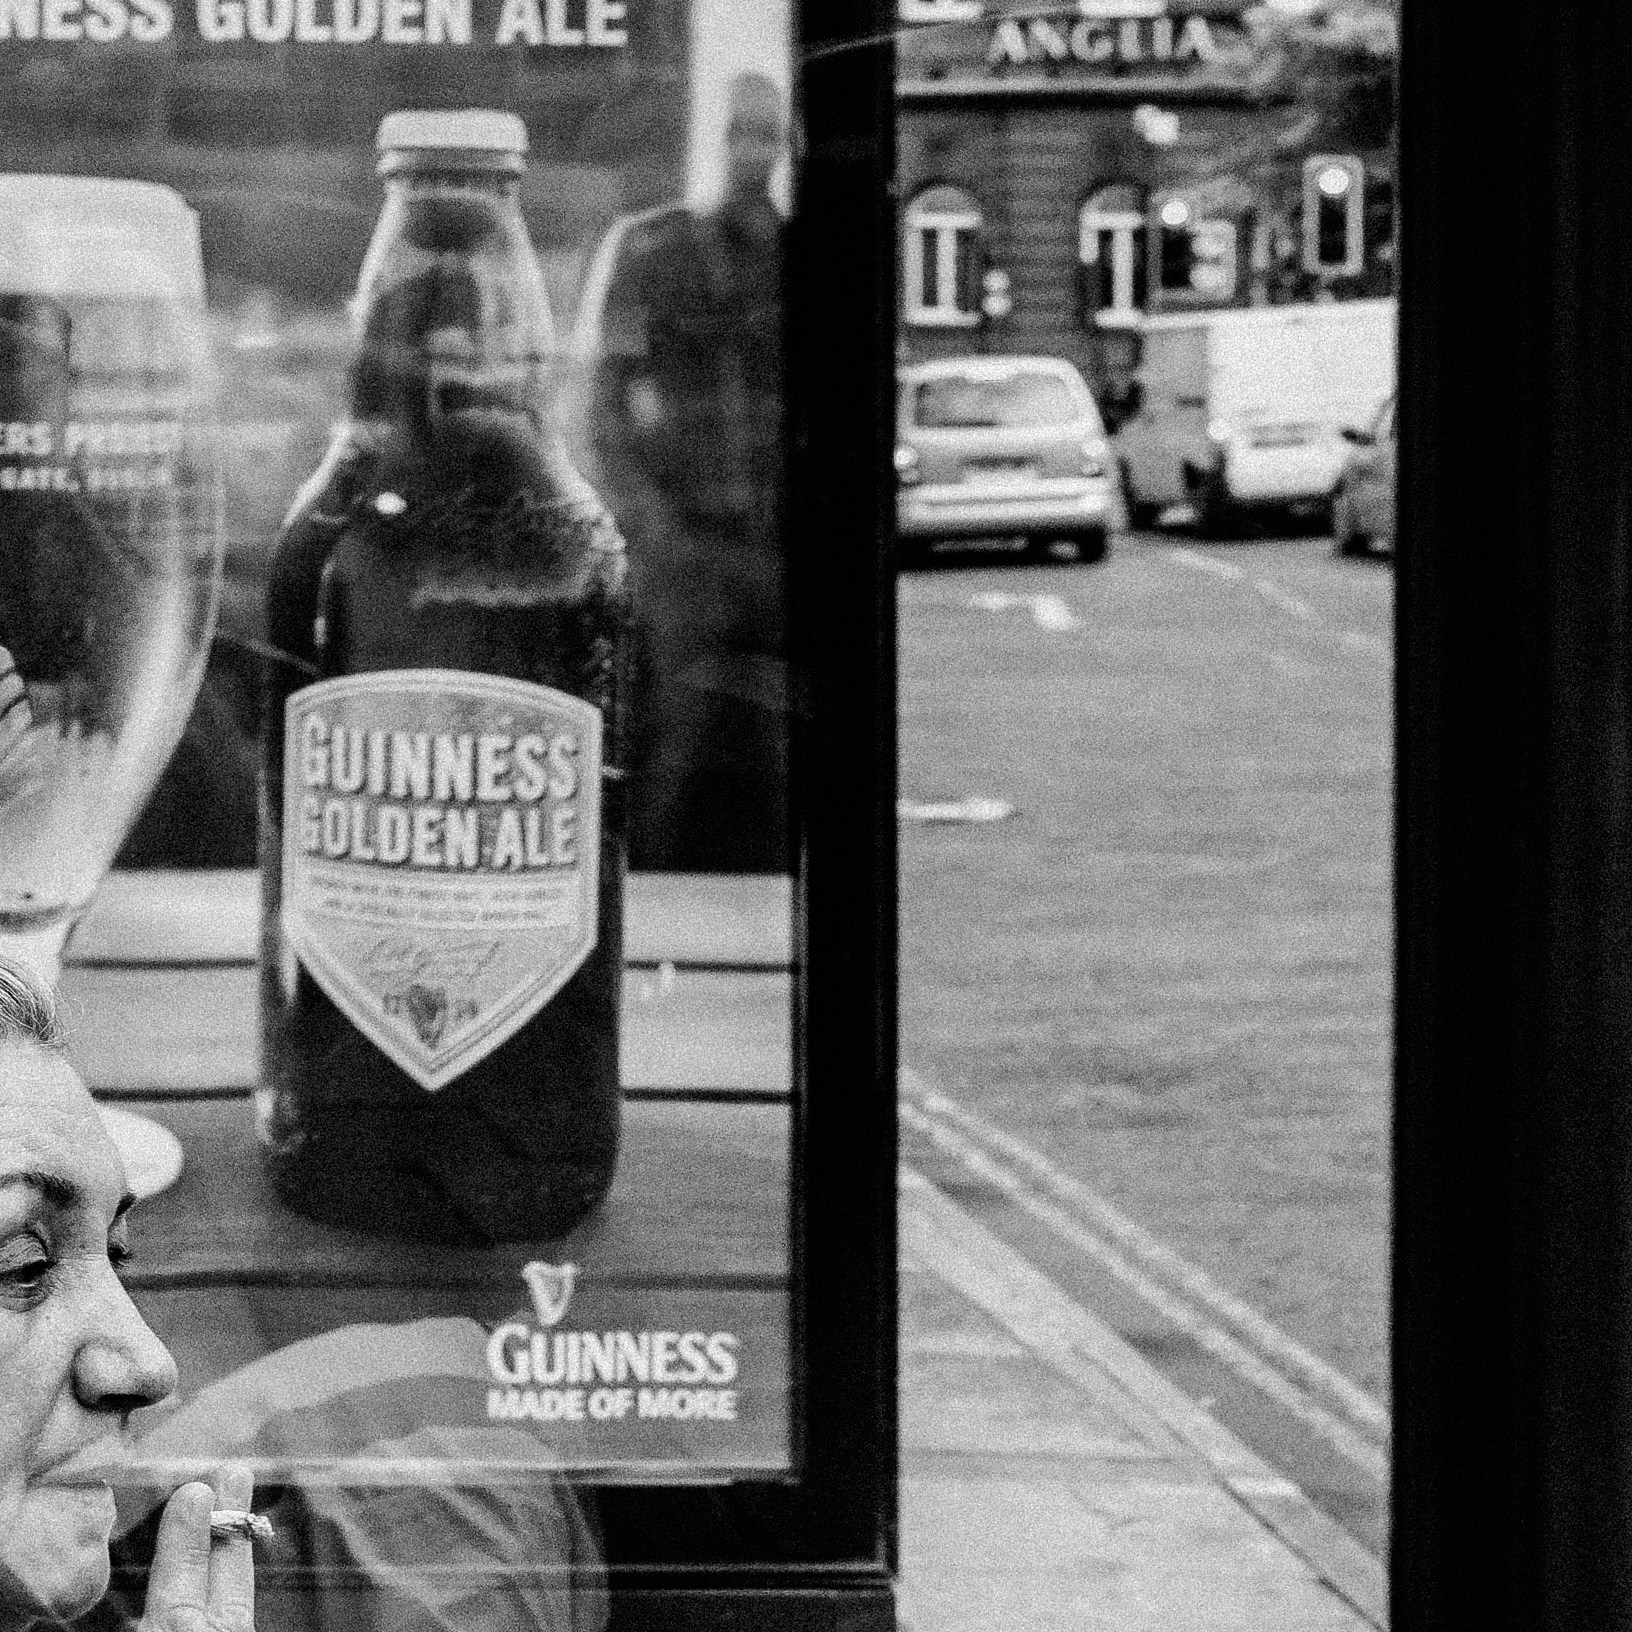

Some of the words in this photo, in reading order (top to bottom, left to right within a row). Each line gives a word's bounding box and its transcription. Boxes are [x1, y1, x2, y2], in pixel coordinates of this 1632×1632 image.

[196, 0, 473, 44] GOLDEN
[495, 0, 628, 46] ALE
[987, 17, 1216, 63] ANGLIA
[303, 711, 579, 801] GUINNESS
[303, 794, 479, 868] GOLDEN
[493, 803, 578, 869] ALE
[487, 1322, 739, 1385] GUINNESS
[486, 1388, 585, 1421] MADE
[589, 1388, 632, 1421] OF
[638, 1388, 739, 1421] MORE
